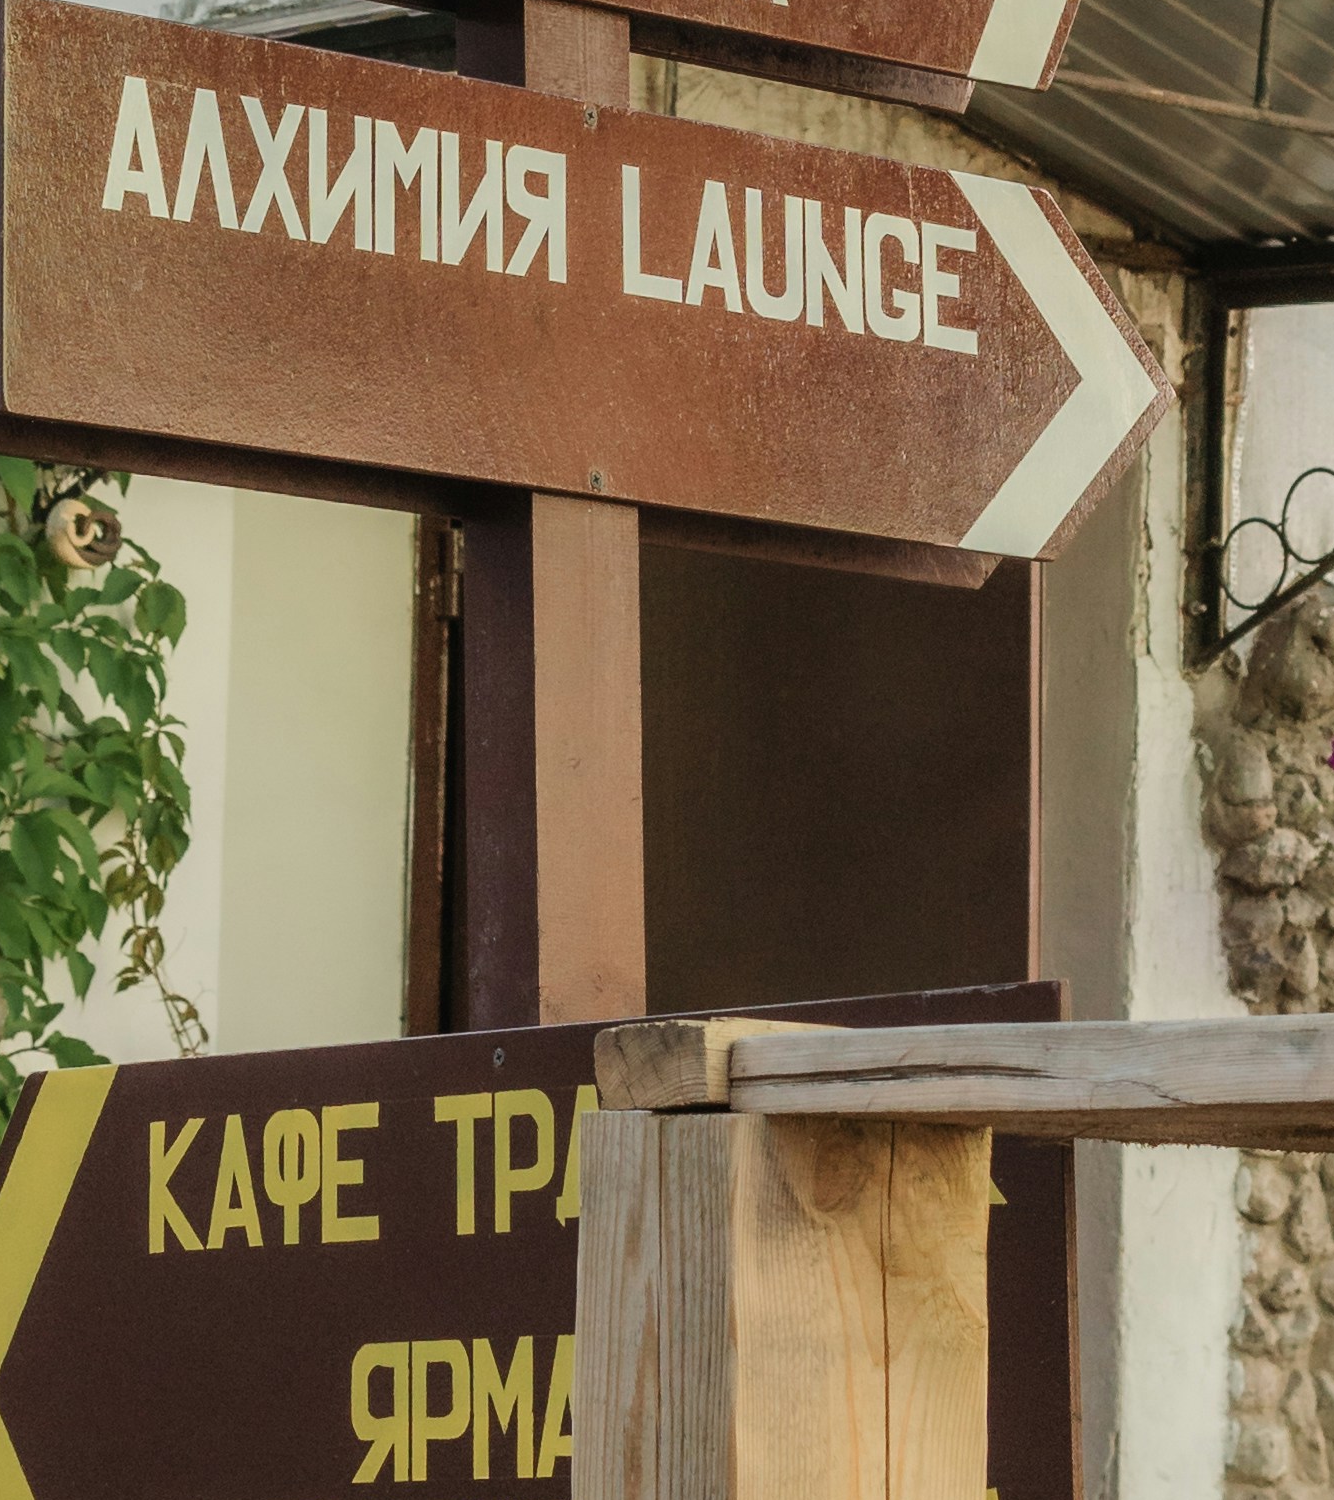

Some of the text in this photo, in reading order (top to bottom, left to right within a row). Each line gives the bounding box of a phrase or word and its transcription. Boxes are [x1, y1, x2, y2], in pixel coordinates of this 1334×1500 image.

[101, 75, 979, 356] АЛХИМИЯ LAUNGE
[148, 1101, 380, 1255] КАФЕ
